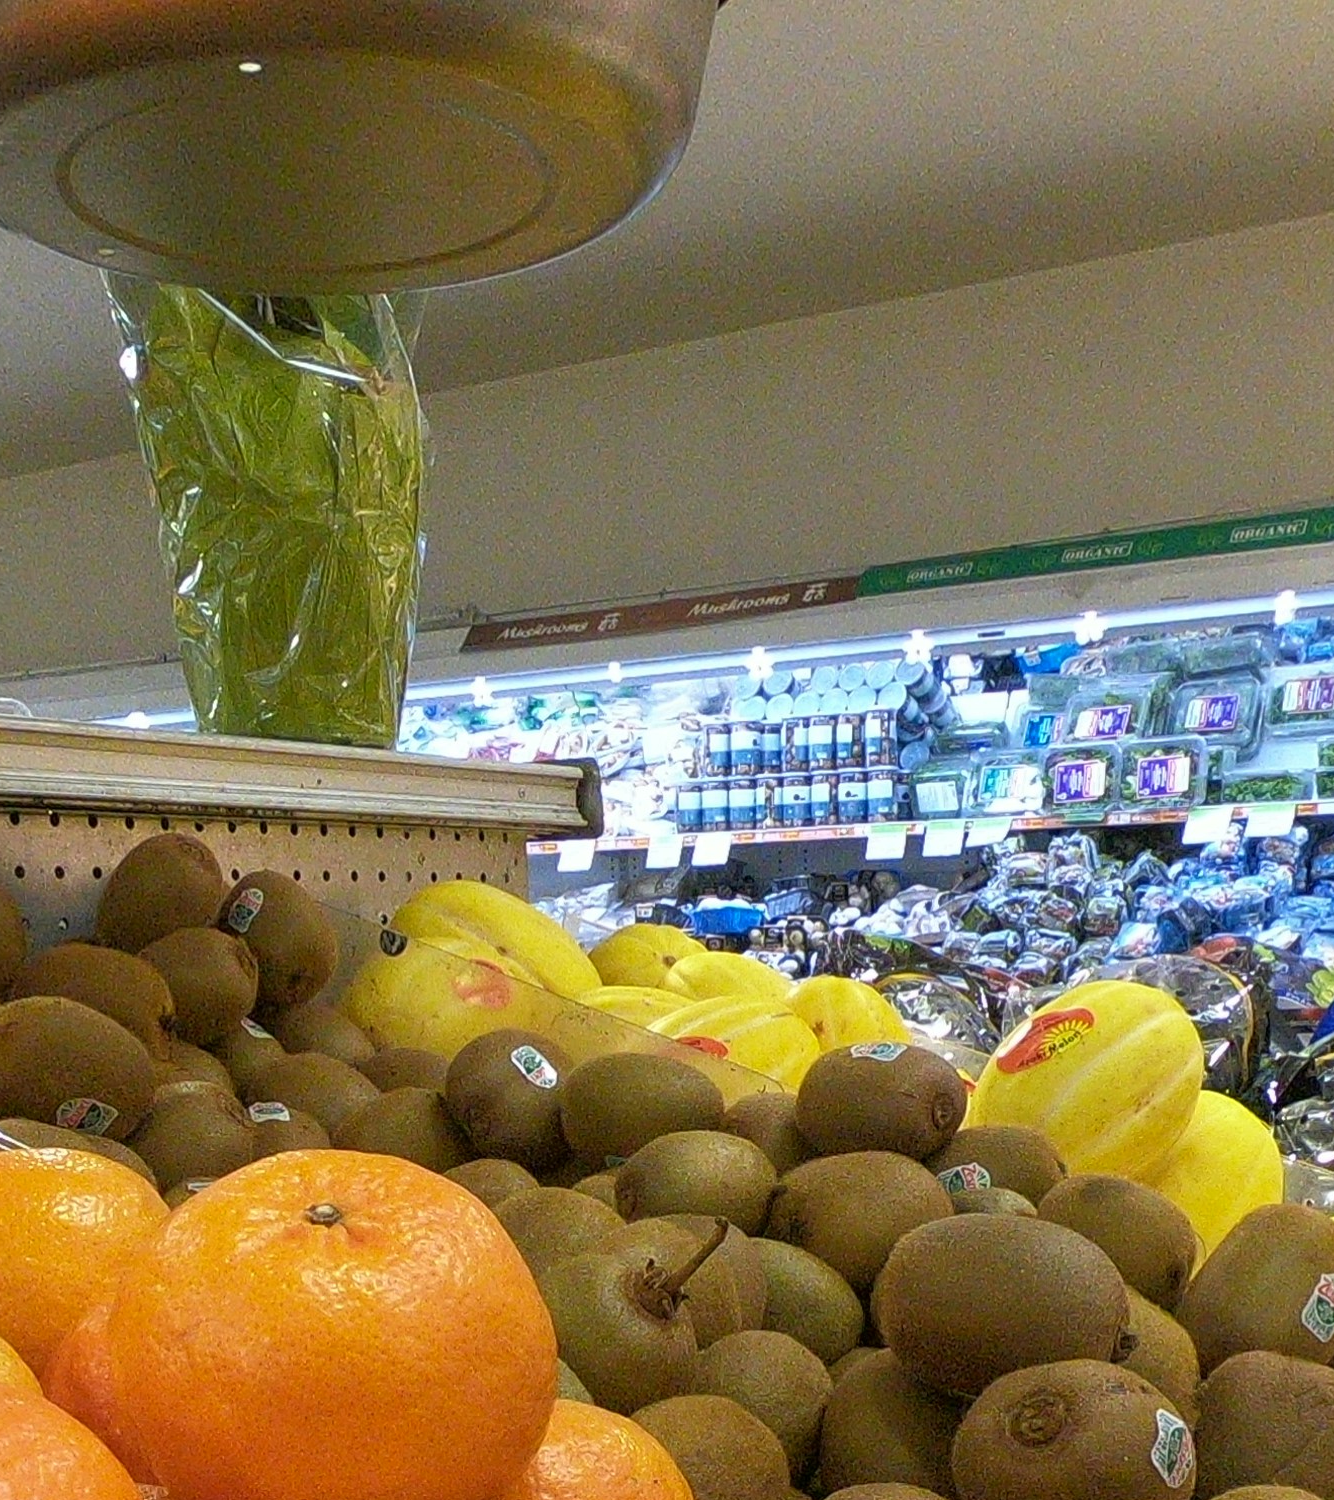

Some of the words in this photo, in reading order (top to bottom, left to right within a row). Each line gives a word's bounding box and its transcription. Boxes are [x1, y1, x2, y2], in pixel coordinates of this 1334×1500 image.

[1234, 523, 1303, 540] ORGANIC
[1066, 545, 1127, 560] ORGANIC
[910, 564, 969, 580] ORGANIC
[687, 594, 789, 617] Mushrooms
[498, 621, 588, 640] Mushrooms
[1047, 1030, 1081, 1056] Melon
